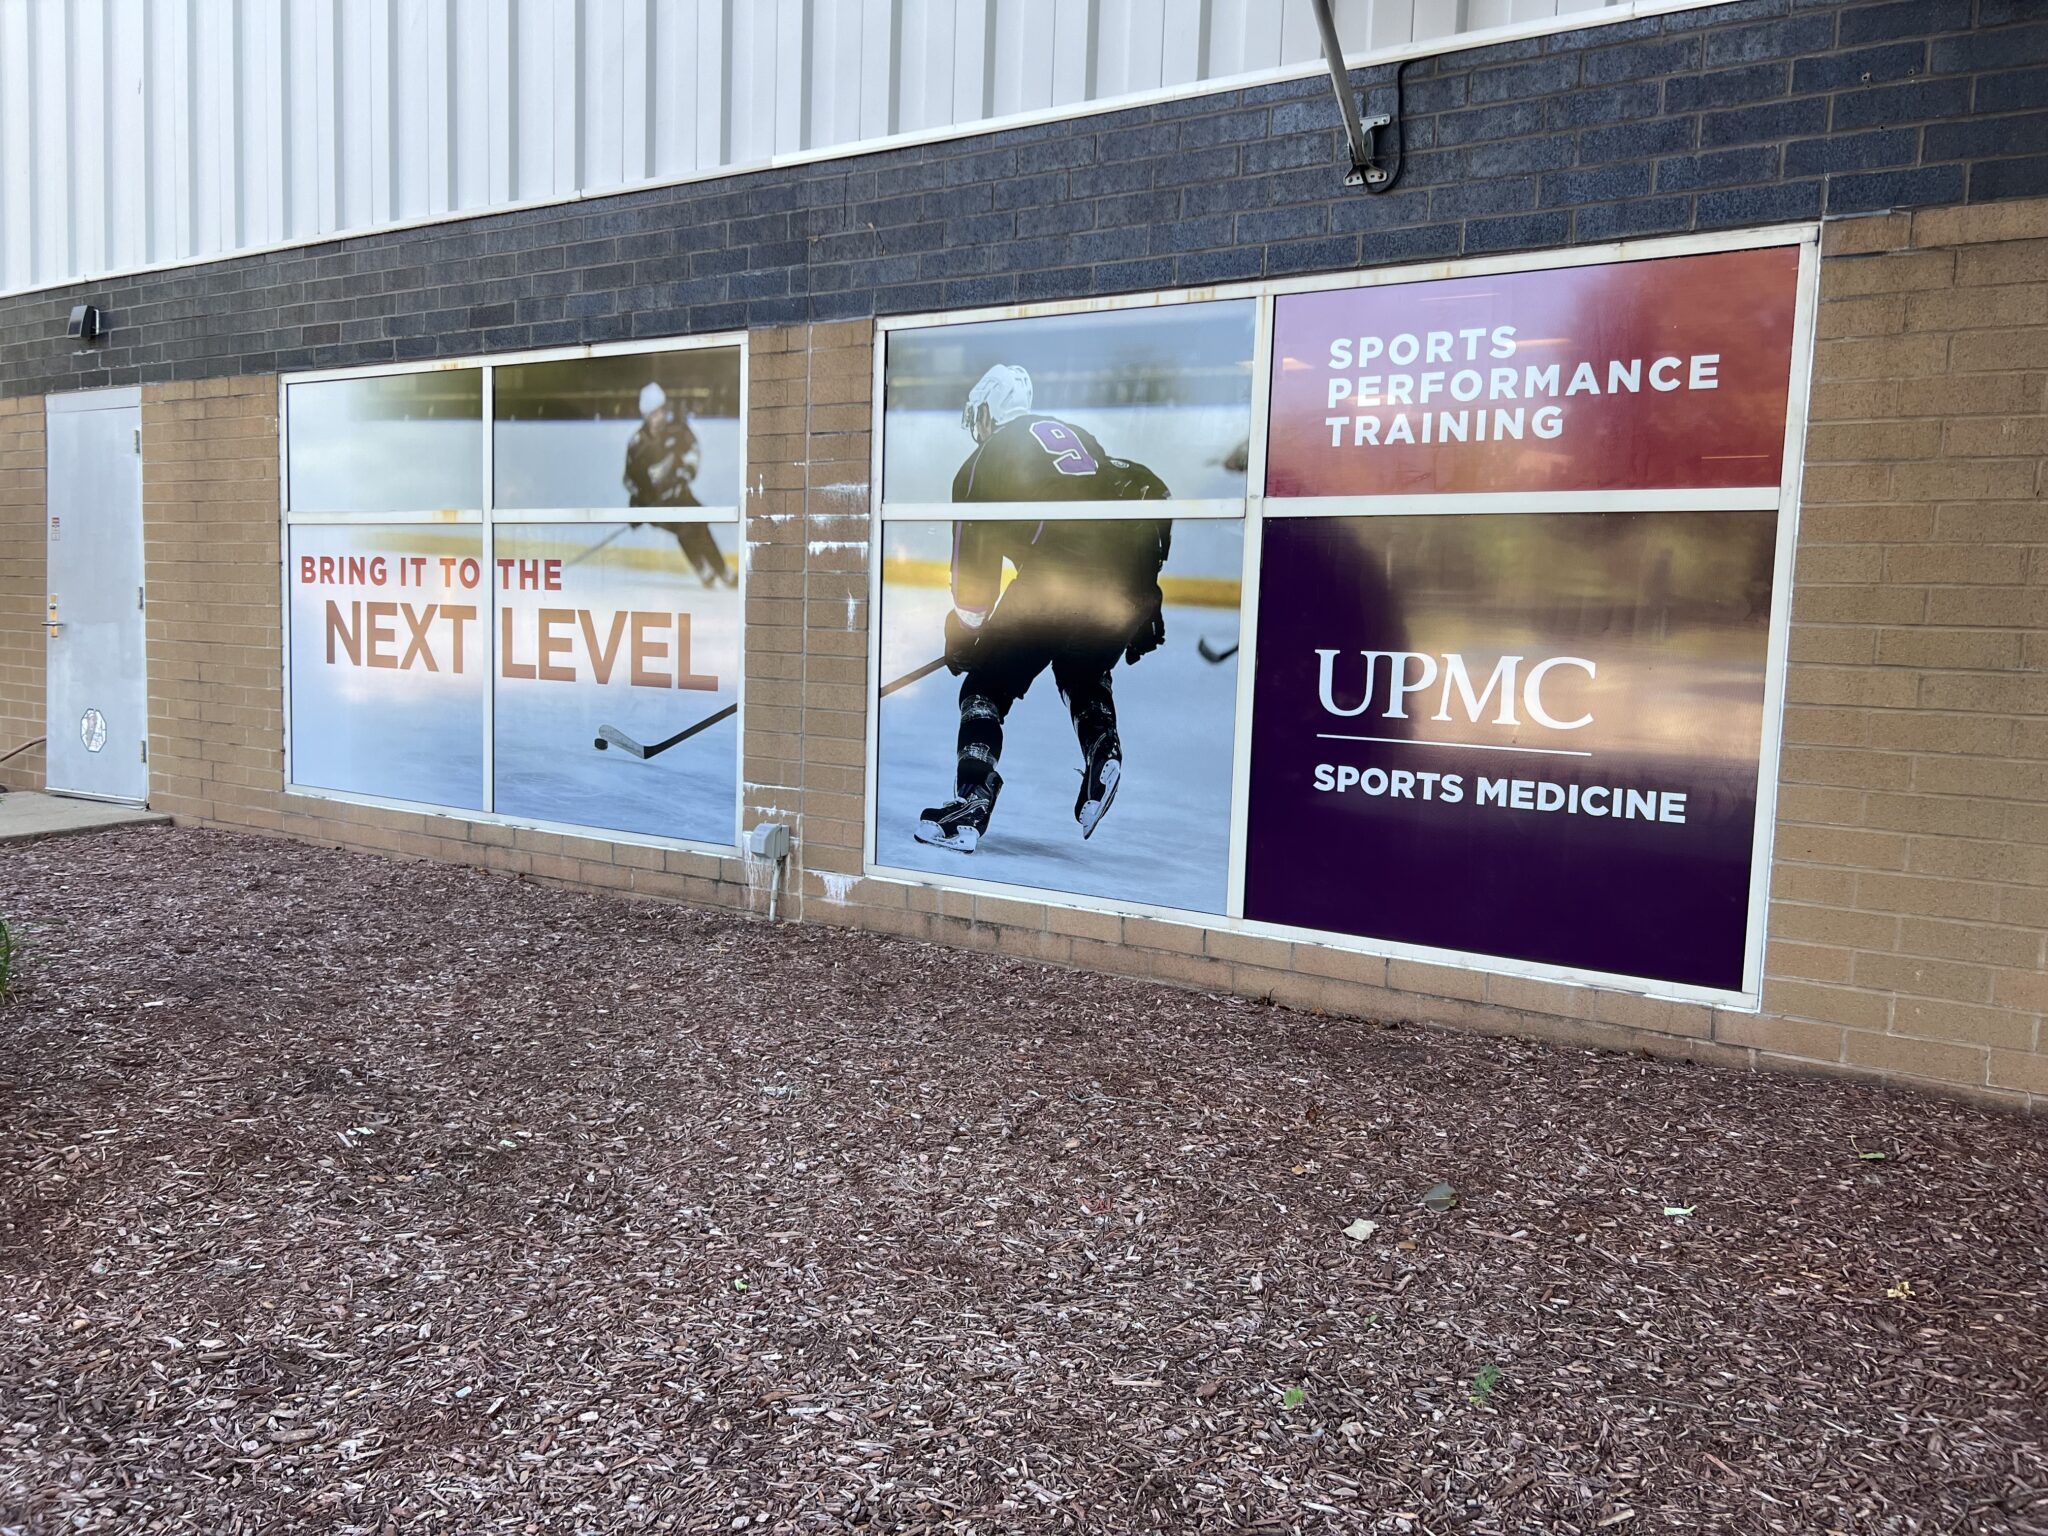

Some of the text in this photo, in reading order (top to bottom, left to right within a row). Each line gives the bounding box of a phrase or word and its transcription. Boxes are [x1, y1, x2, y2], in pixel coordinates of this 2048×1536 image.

[1329, 325, 1517, 370] SPORTS
[1327, 353, 1720, 409] PERFORMANCE
[1029, 420, 1099, 476] 9
[1325, 405, 1563, 447] TRAINING
[301, 555, 562, 590] BRING IT TO THE
[326, 600, 718, 691] NEXT LEVEL
[1314, 649, 1597, 730] UPMC
[1313, 763, 1687, 824] SPORTS MEDICINE
